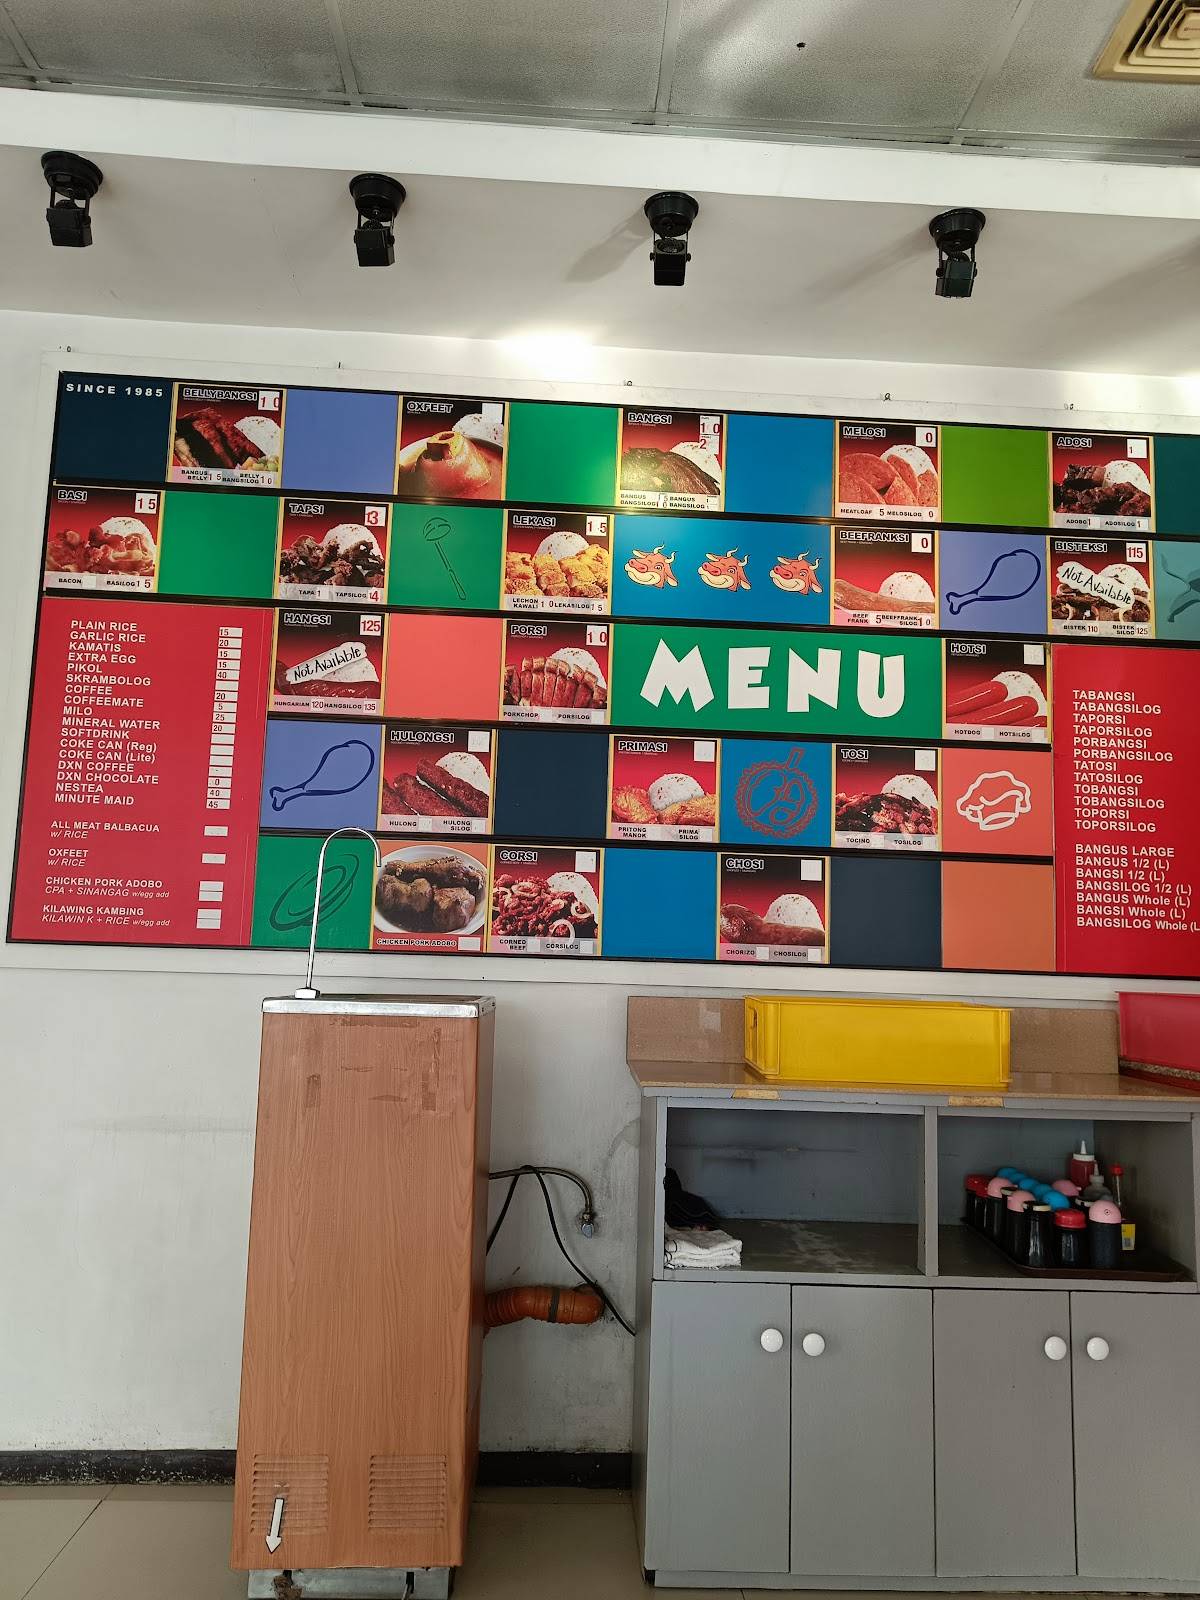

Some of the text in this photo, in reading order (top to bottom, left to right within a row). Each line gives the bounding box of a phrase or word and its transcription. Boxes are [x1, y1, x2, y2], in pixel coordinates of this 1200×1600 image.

[66, 384, 163, 397] SINCE 1985
[183, 388, 258, 401] BELLYBANGSI
[407, 401, 453, 413] OXFEET
[628, 413, 672, 424] BANGSI
[843, 426, 886, 438] MELOSI
[1057, 437, 1092, 448] ADOSI
[58, 490, 87, 500] BASI
[289, 503, 324, 515] TAPSI
[513, 515, 556, 527] LEKASI
[840, 531, 910, 543] BEEFRANKSI
[1055, 542, 1108, 553] BISTEKSI
[1127, 547, 1143, 558] 115
[1062, 566, 1132, 605] Not Available
[284, 613, 332, 625] HANGSI
[71, 620, 137, 631] PLAIN RICE
[361, 621, 381, 632] 125
[510, 624, 548, 636] PORSI
[70, 631, 146, 642] GARLIC RICE
[69, 642, 122, 652] KAMATIS
[950, 643, 986, 654] HOTSI
[68, 653, 136, 664] EXTRA EGG
[294, 647, 362, 682] Not Available
[67, 664, 103, 673] PIKOL
[66, 674, 151, 686] SKRAMBOLOG
[640, 638, 905, 718] MENU
[65, 685, 112, 695] COFFEE
[1073, 690, 1135, 702] TABANGSI
[64, 696, 144, 708] COFFEEMATE
[1073, 702, 1162, 714] TABANGSILOG
[63, 707, 93, 716] MILO
[62, 717, 160, 730] MINERAL WATER
[1073, 714, 1126, 725] TAPORSI
[61, 728, 130, 740] SOFTDRINK
[391, 730, 454, 743] HULONGSI
[1073, 725, 1153, 738] TAPORSILOG
[60, 739, 157, 753] COKE CAN (Reg)
[618, 741, 668, 752] PRIMASI
[1074, 737, 1147, 749] PORBANGSI
[59, 750, 156, 763] COKE CAN (Lite)
[841, 749, 869, 760] TOSI
[1074, 749, 1173, 762] PORBANGSILOG
[58, 761, 134, 773] DXN COFFEE
[1074, 761, 1117, 772] TATOSI
[57, 772, 159, 784] DXN CHOCOLATE
[1074, 772, 1143, 784] TATOSILOG
[56, 782, 104, 793] NESTEA
[1074, 784, 1139, 796] TOBANGSI
[55, 793, 134, 805] MINUTE MAID
[1074, 796, 1165, 809] TOBANGSILOG
[1075, 808, 1129, 820] TOPORSI
[51, 821, 160, 832] ALL MEAT BALBACUA
[1075, 820, 1156, 832] TOPORSILOG
[64, 831, 88, 839] RICE
[49, 849, 89, 858] OXFEET
[500, 850, 538, 862] CORSI
[1075, 844, 1175, 858] BANGUS LARGE
[60, 859, 86, 867] RICE
[726, 858, 764, 870] CHOSI
[1076, 856, 1170, 871] BANGUS 1/2 (L)
[1076, 868, 1166, 882] BANGSI 1/2 (L)
[46, 877, 162, 888] CHICKEN PORK ADOBO
[1076, 880, 1192, 896] BANGSILOG 1/2 (L)
[45, 886, 66, 894] CPA
[76, 888, 129, 897] SINANGAG
[1077, 893, 1191, 908] BANGUS Whole (L)
[43, 905, 144, 916] KILAWING KAMBING
[1077, 905, 1186, 920] BANGSI Whole (L)
[42, 914, 84, 924] KILAWIN
[87, 916, 94, 924] K
[105, 916, 130, 925] RICE
[1077, 917, 1188, 931] BANGSILOG Whole
[377, 938, 408, 946] CHICKEN
